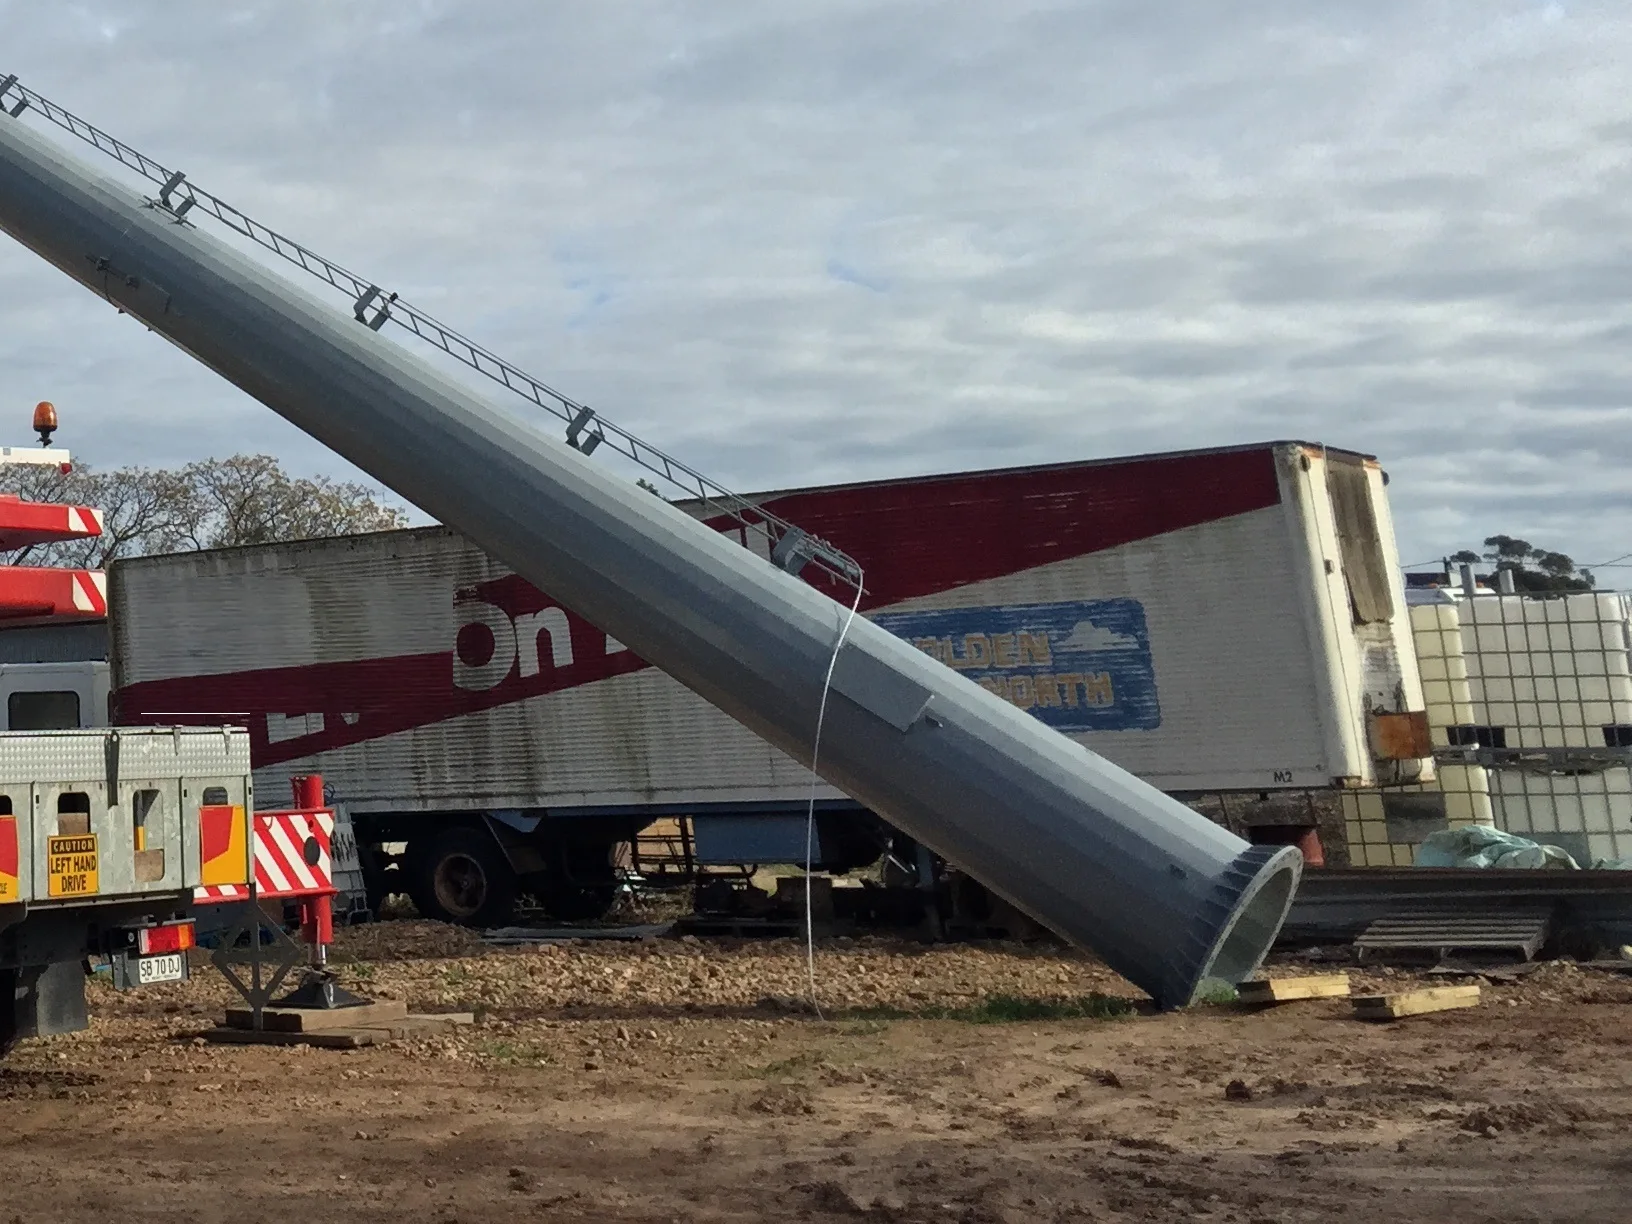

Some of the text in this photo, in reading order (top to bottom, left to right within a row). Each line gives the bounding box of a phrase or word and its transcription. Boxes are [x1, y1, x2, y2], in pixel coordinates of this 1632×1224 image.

[53, 839, 94, 853] CAUTION
[50, 855, 96, 874] LEFT HAND
[62, 874, 87, 892] DRIVE
[141, 960, 153, 977] SB
[155, 958, 167, 975] 70
